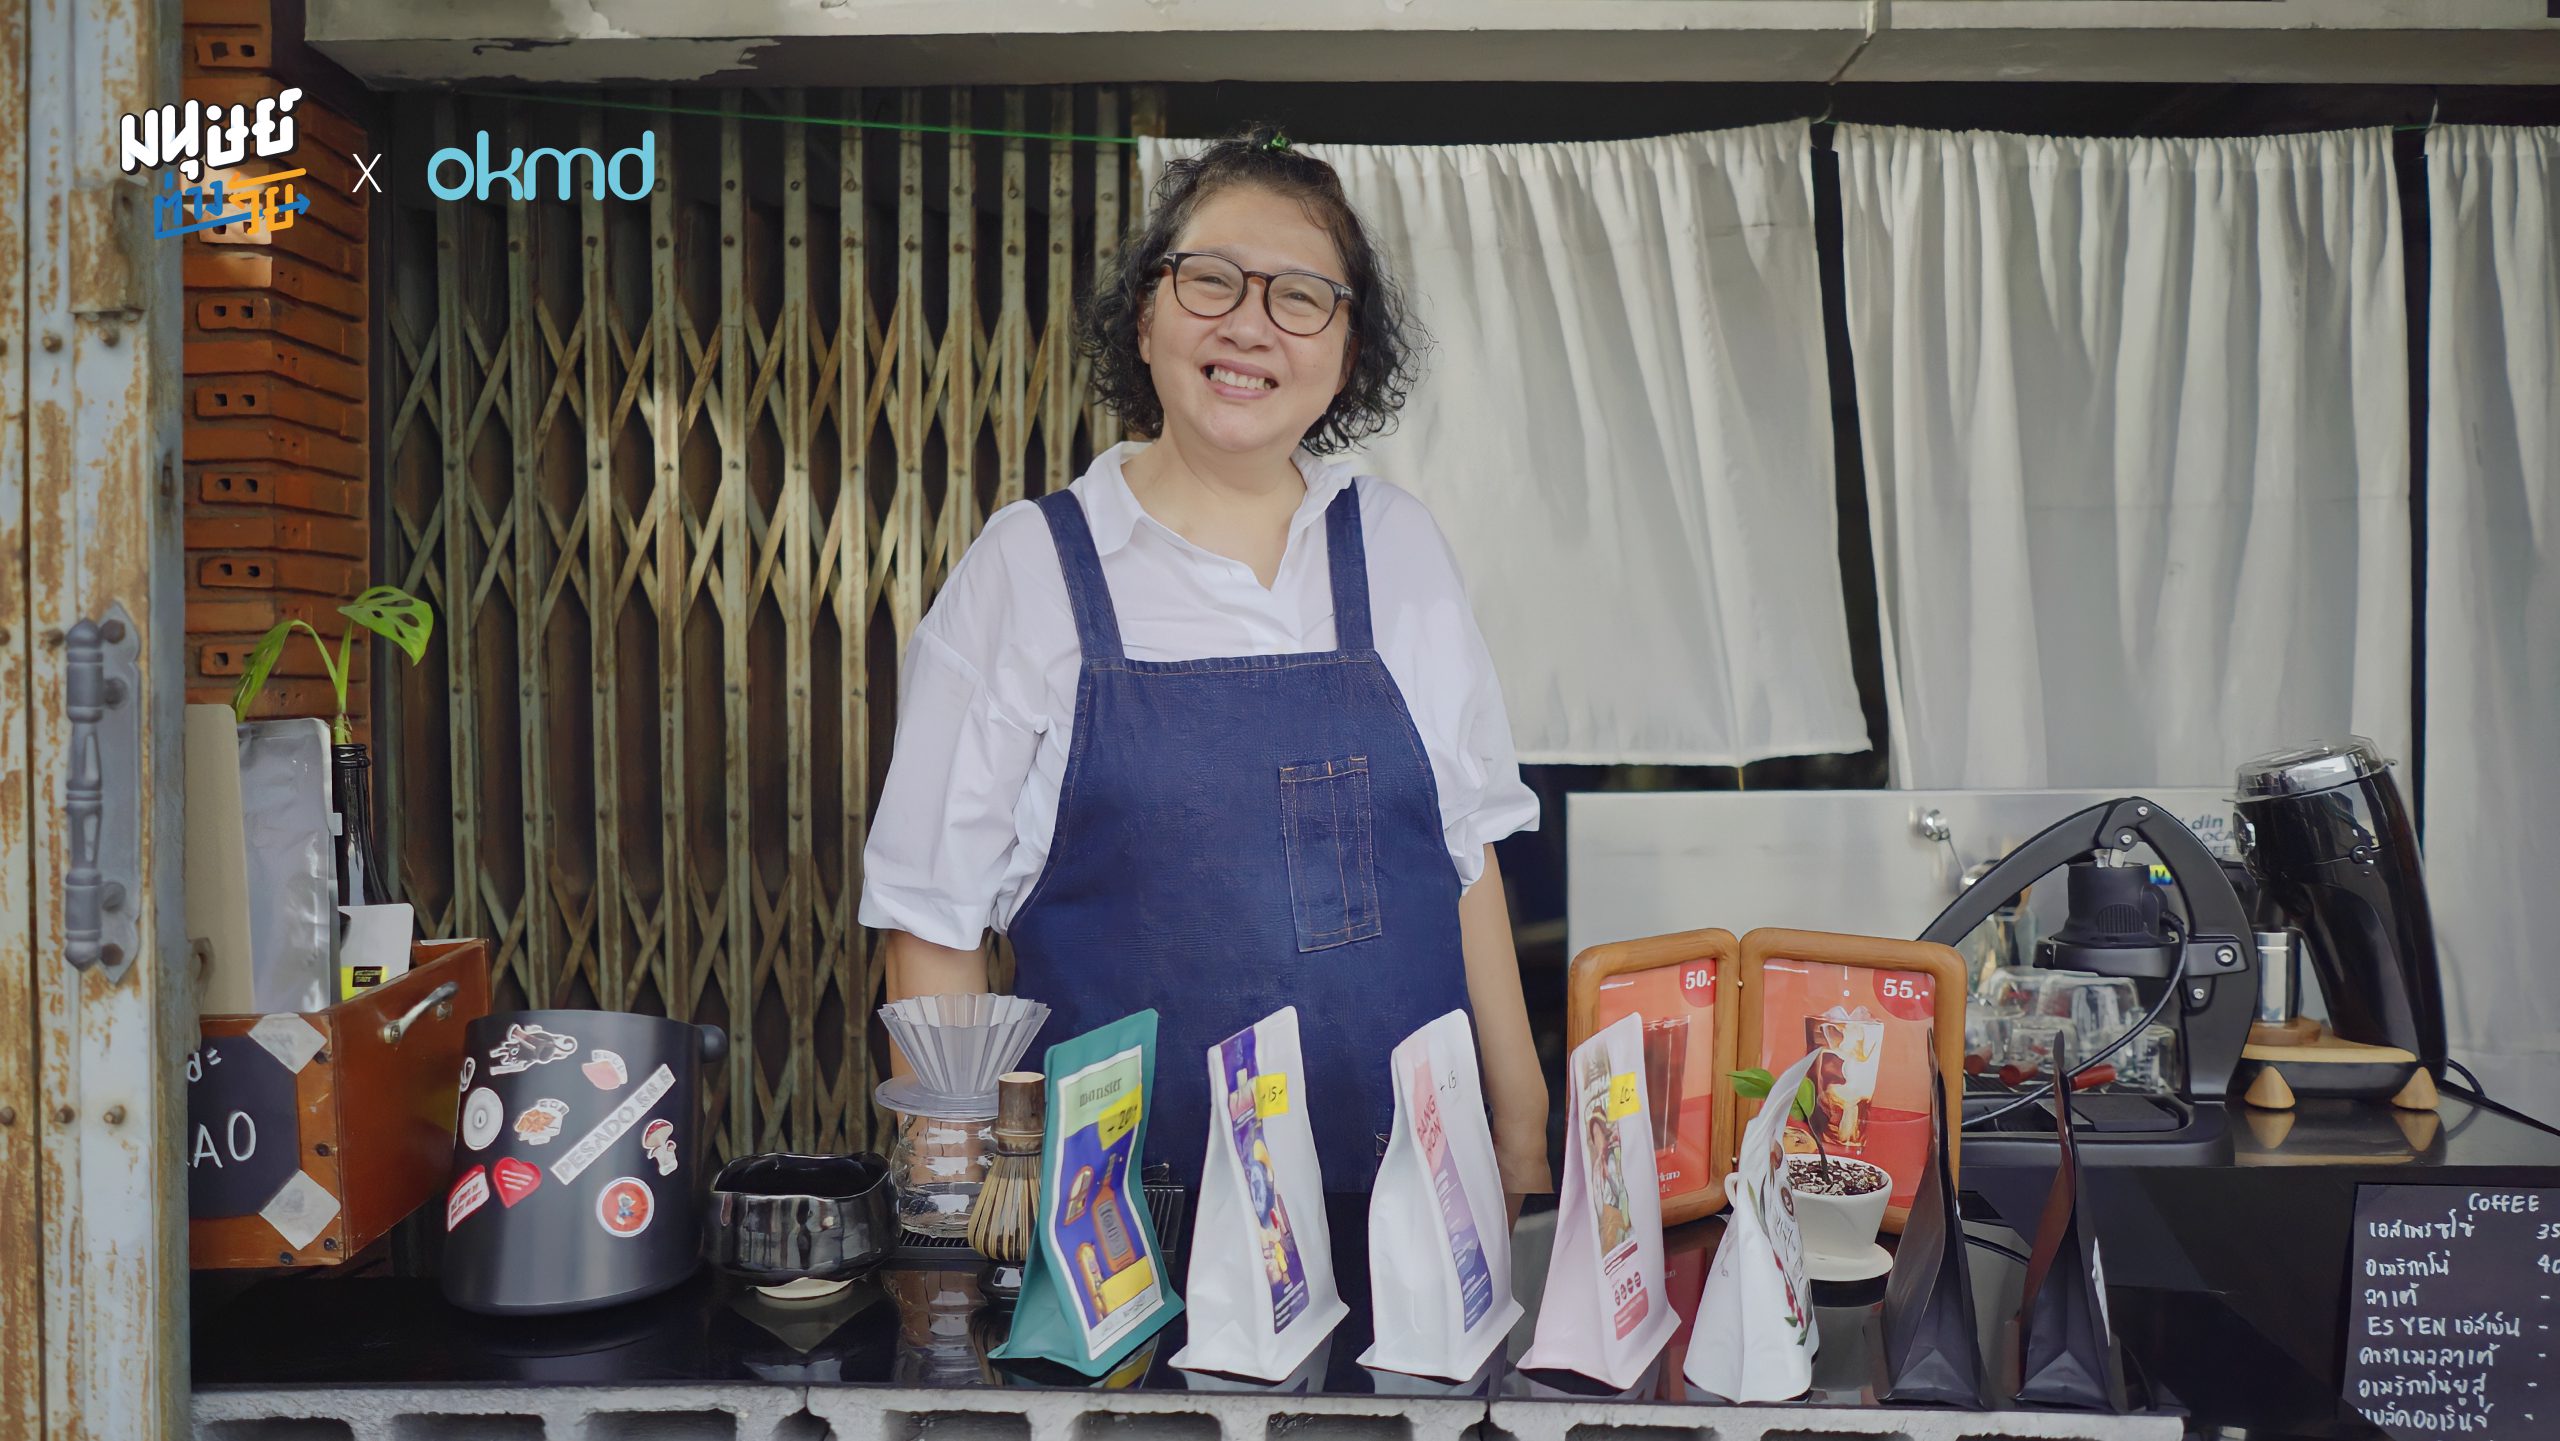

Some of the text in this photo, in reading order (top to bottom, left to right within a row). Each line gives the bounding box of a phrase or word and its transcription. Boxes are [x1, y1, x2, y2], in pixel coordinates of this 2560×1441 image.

[1883, 978, 1929, 1000] 55.-
[188, 1110, 257, 1169] AO
[2367, 1315, 2394, 1336] ES
[2399, 1316, 2446, 1337] YEN
